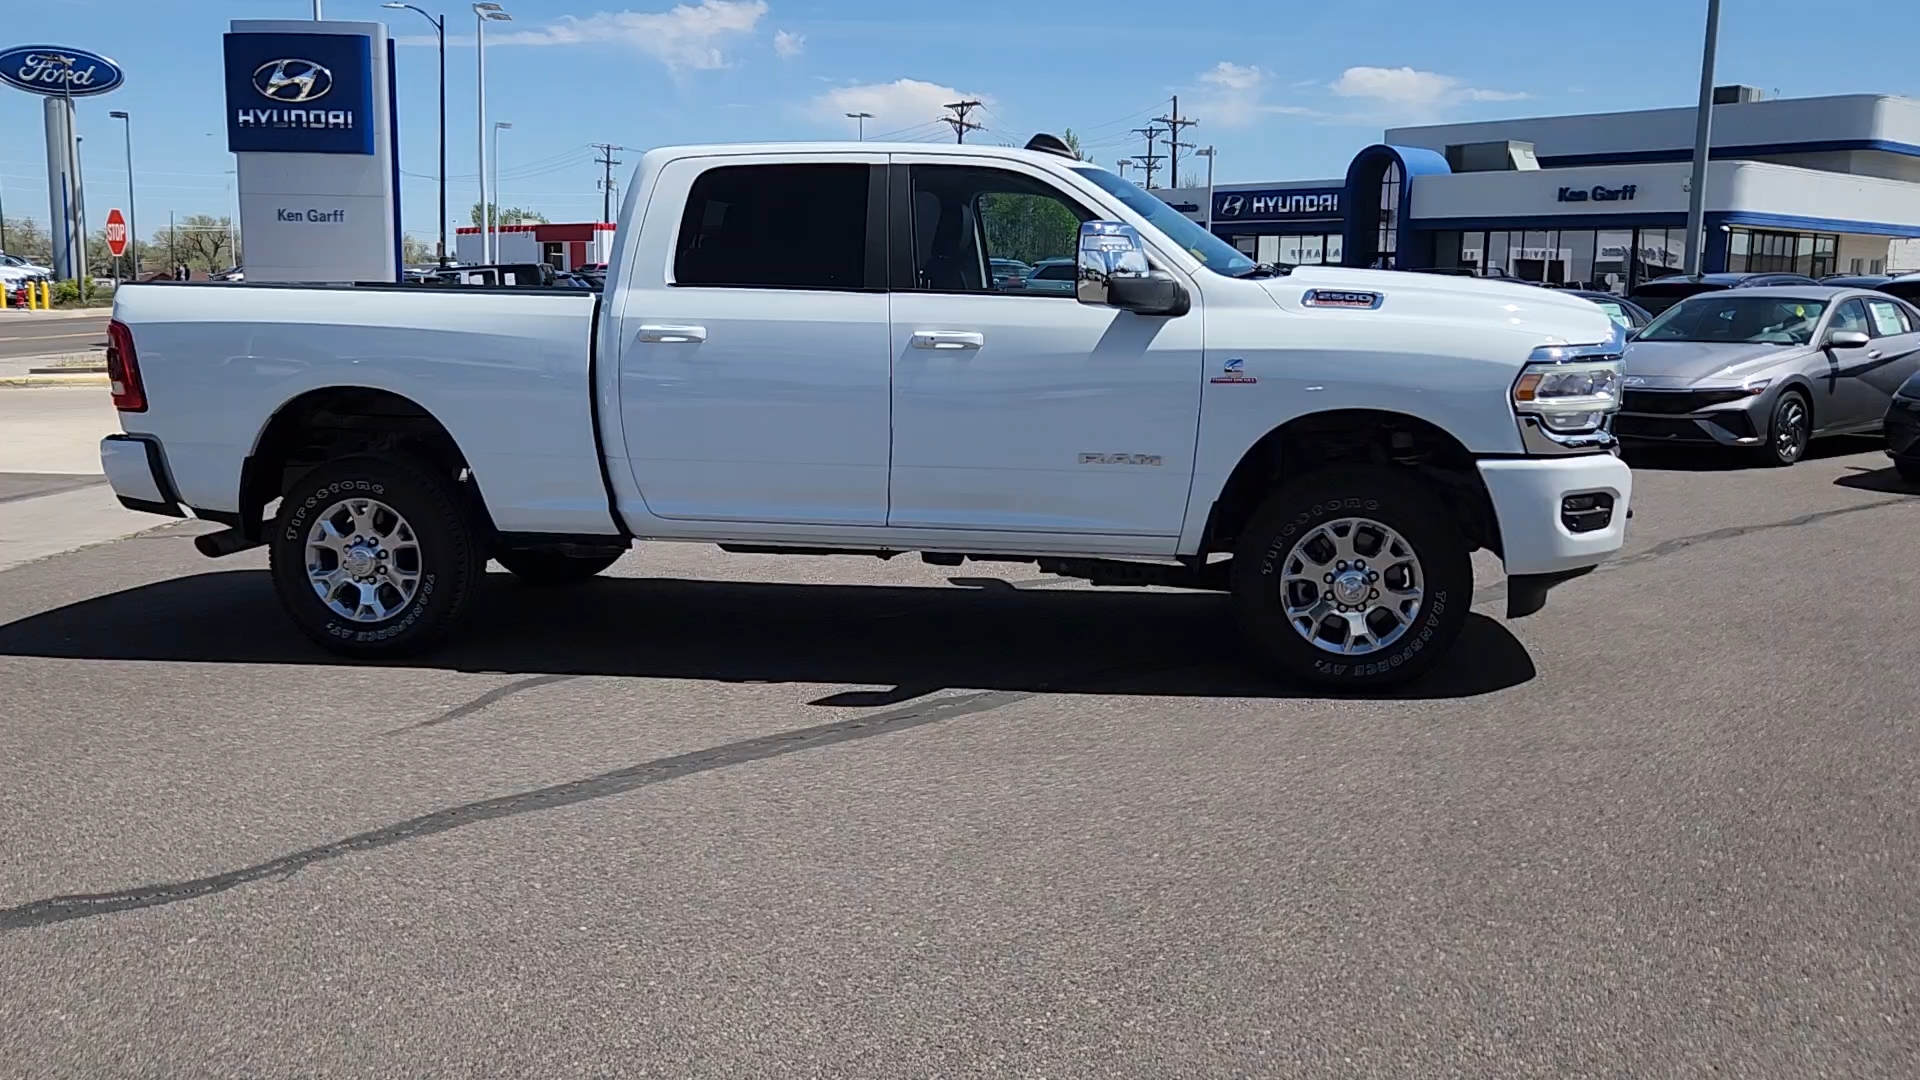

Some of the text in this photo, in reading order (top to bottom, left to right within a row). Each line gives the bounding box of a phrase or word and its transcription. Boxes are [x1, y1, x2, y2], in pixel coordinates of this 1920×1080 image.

[18, 54, 97, 85] Ford
[237, 108, 354, 129] HYUNDAI
[1557, 184, 1638, 202] Ken Garff
[1252, 193, 1339, 214] HYUNDAI
[277, 208, 345, 223] Ken Garff
[107, 223, 125, 241] STOP
[1077, 452, 1163, 466] RAM
[1353, 590, 1448, 677] TRANSFORCE
